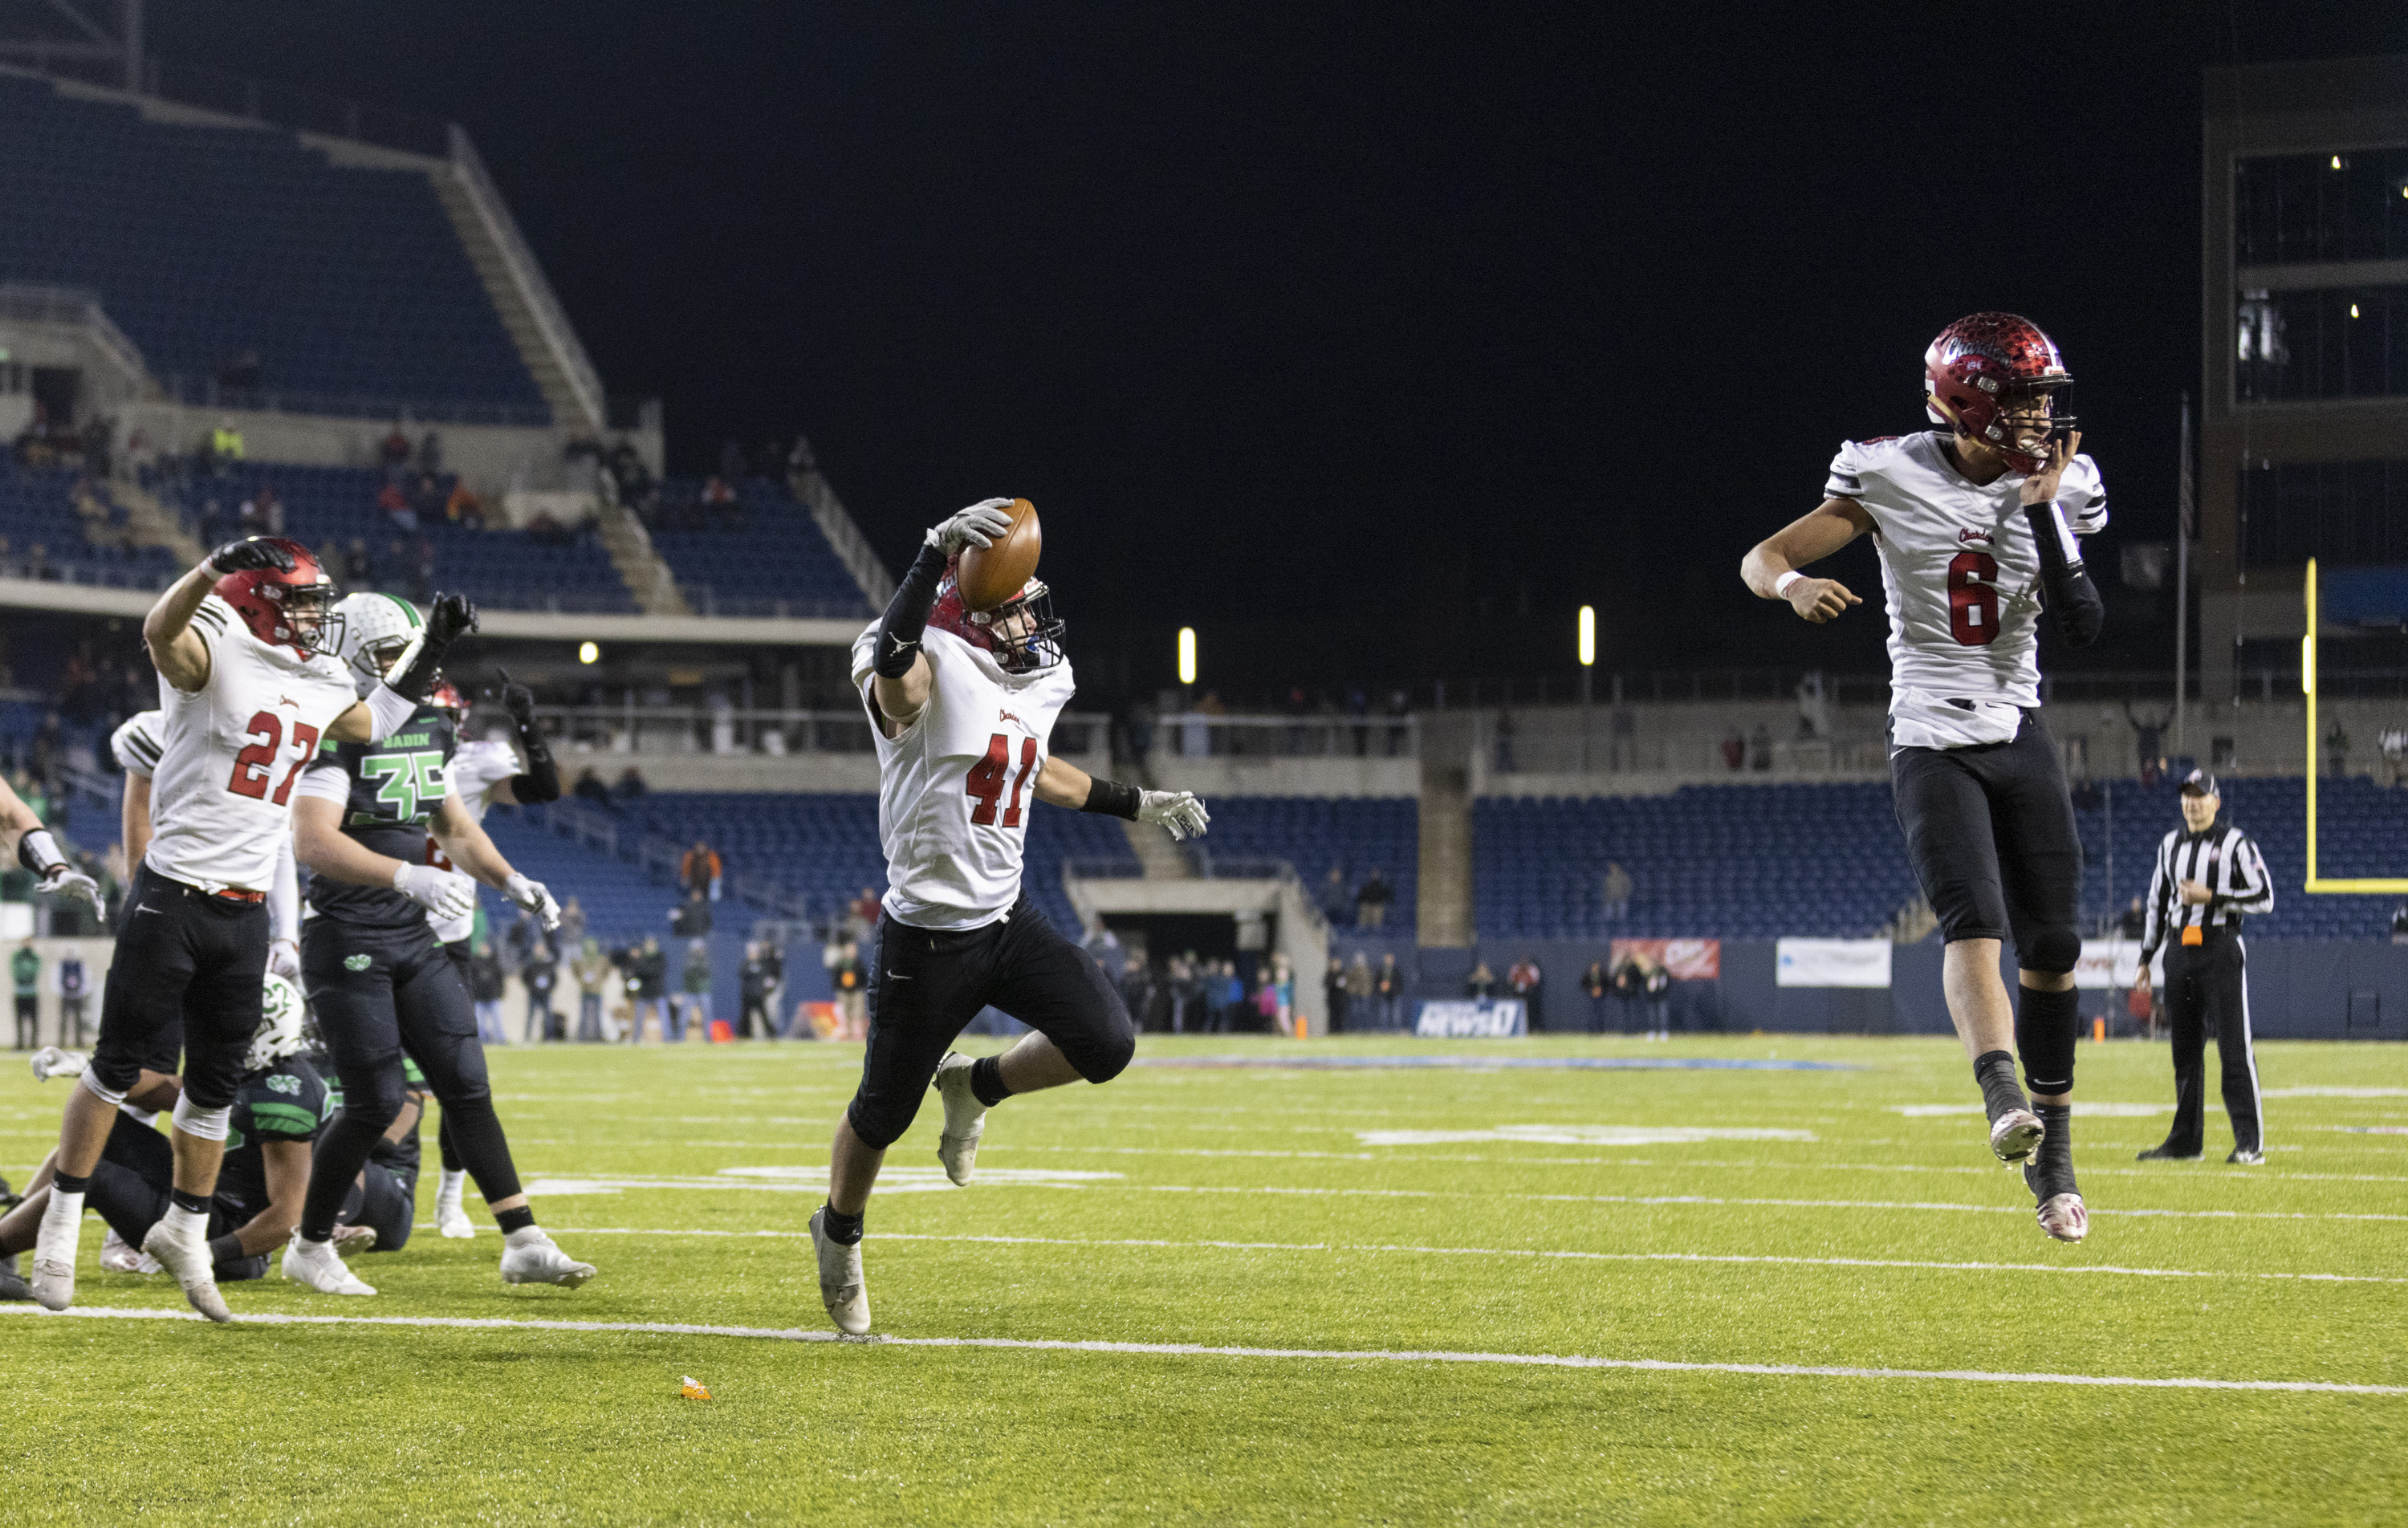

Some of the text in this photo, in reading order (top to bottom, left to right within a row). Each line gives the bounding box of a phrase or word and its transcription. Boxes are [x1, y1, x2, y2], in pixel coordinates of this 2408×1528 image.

[1947, 551, 1999, 646] 6
[226, 709, 319, 807] 27
[966, 733, 1037, 828] 41
